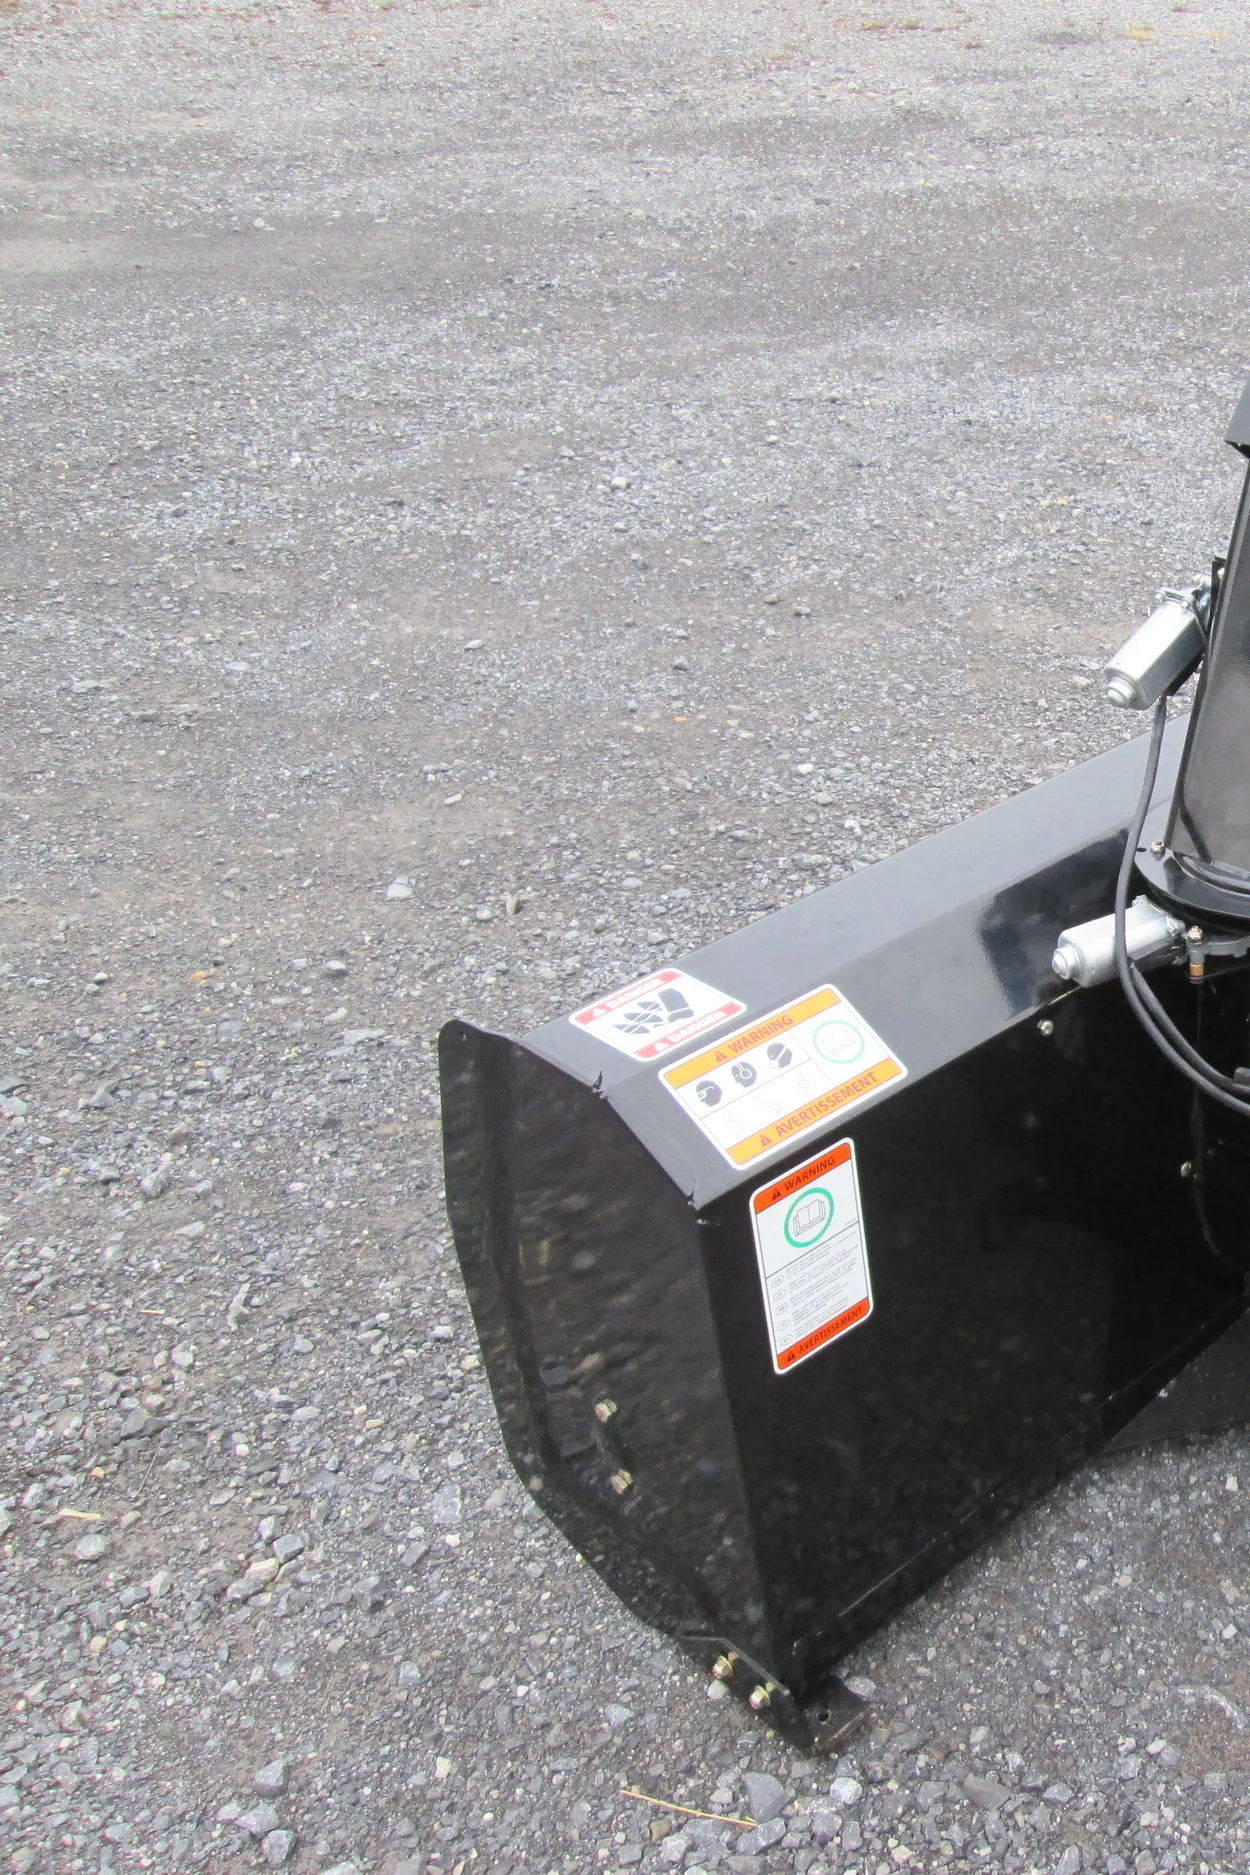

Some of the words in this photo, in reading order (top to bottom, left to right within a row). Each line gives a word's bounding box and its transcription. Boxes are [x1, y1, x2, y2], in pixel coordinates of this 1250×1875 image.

[608, 978, 664, 1009] DANGER
[670, 1011, 726, 1043] DANGER
[728, 1014, 795, 1054] WARNING
[774, 1071, 879, 1137] AVERTISSEMENT
[784, 1155, 836, 1191] WARNING
[798, 1306, 864, 1355] AVERTISSEMENT
